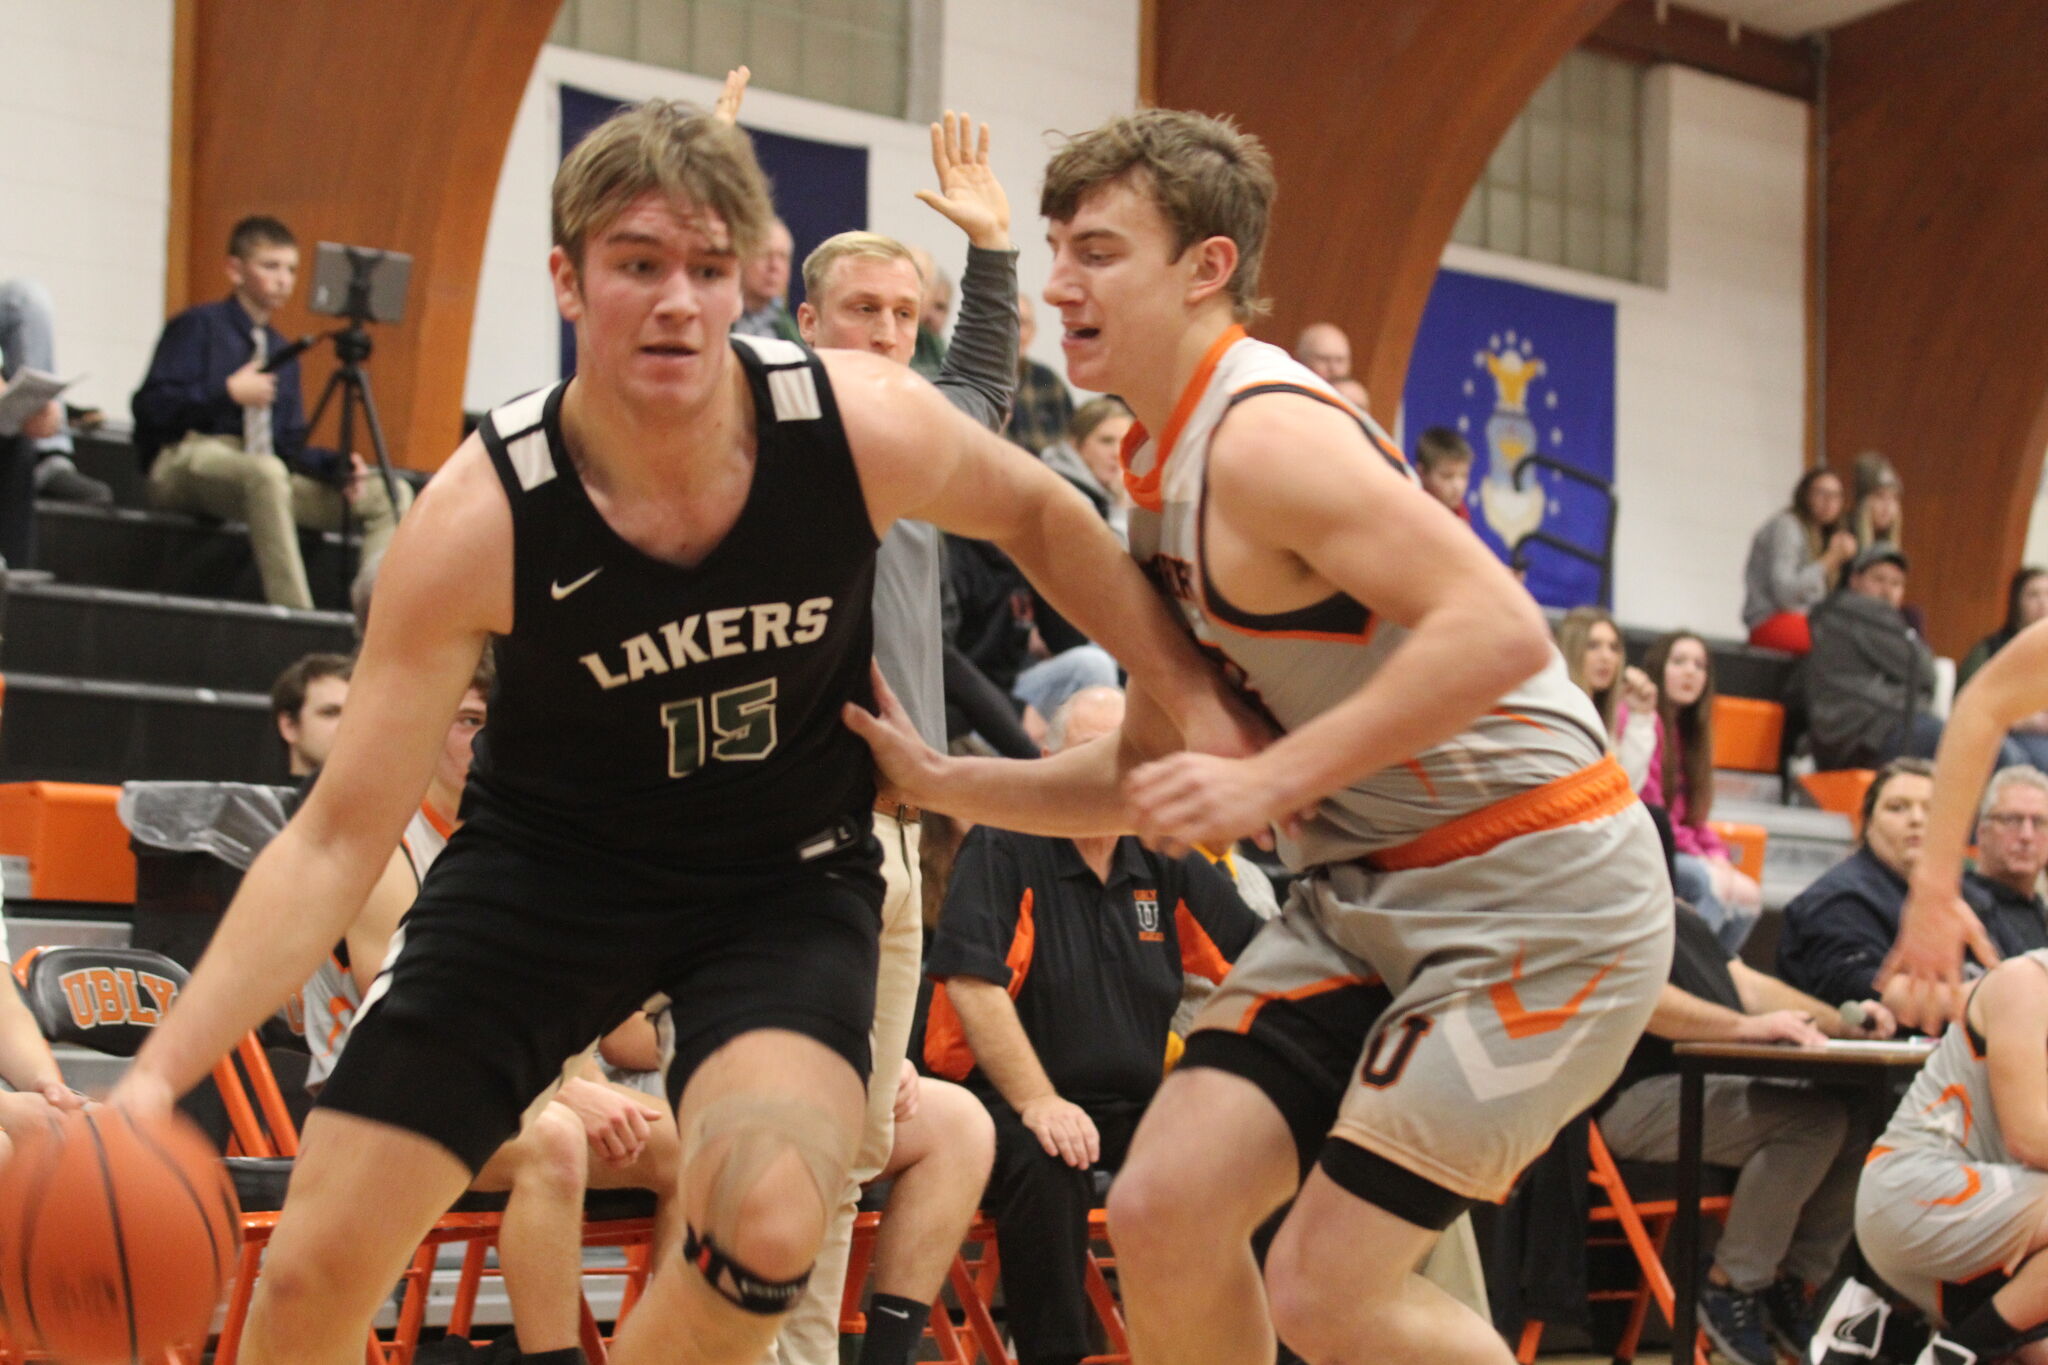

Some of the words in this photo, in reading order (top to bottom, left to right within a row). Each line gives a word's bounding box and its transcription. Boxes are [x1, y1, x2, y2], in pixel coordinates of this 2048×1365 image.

[579, 596, 833, 690] LAKERS
[660, 676, 778, 779] 15
[1135, 901, 1160, 932] U
[58, 966, 179, 1030] UBLY
[1360, 1013, 1435, 1091] U
